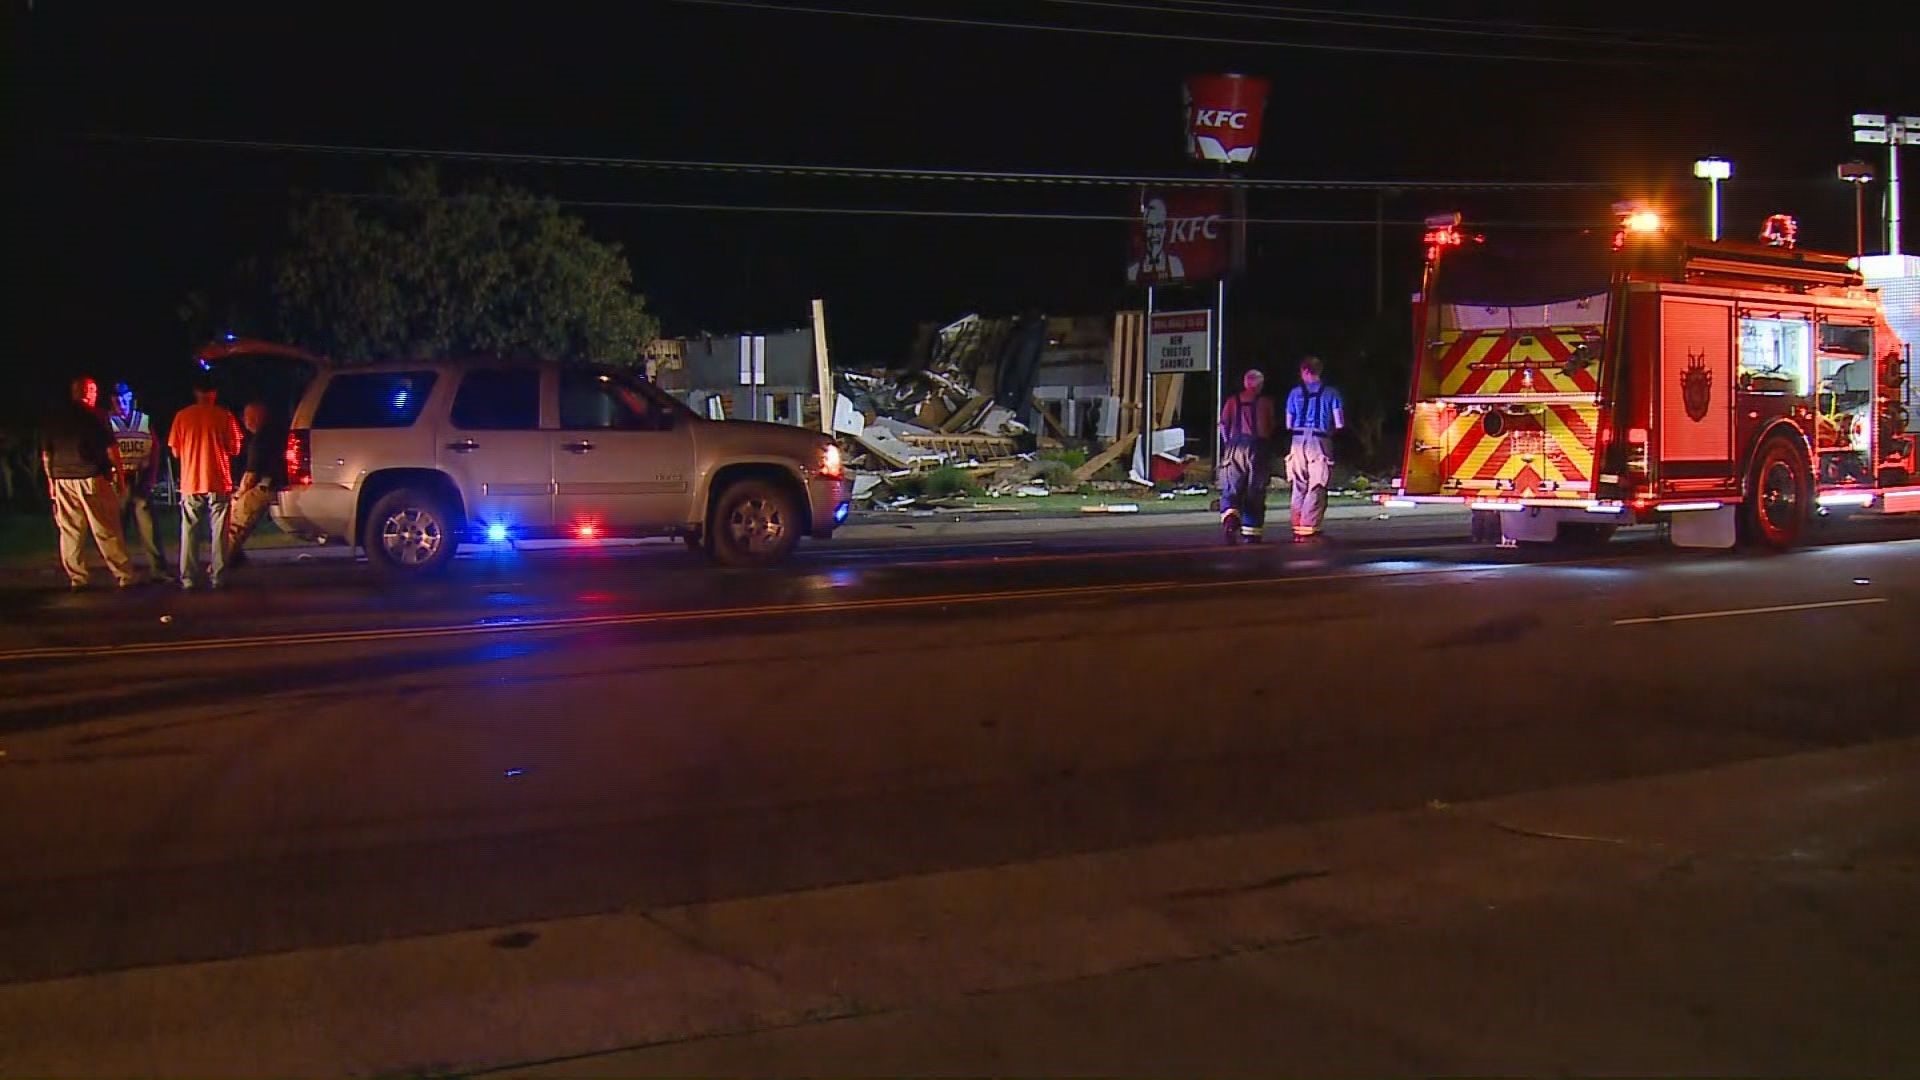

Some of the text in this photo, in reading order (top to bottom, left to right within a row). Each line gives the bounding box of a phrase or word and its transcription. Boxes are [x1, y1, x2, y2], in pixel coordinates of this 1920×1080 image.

[1195, 108, 1248, 129] KFC
[1169, 214, 1220, 243] KFC
[117, 440, 144, 453] OLICE
